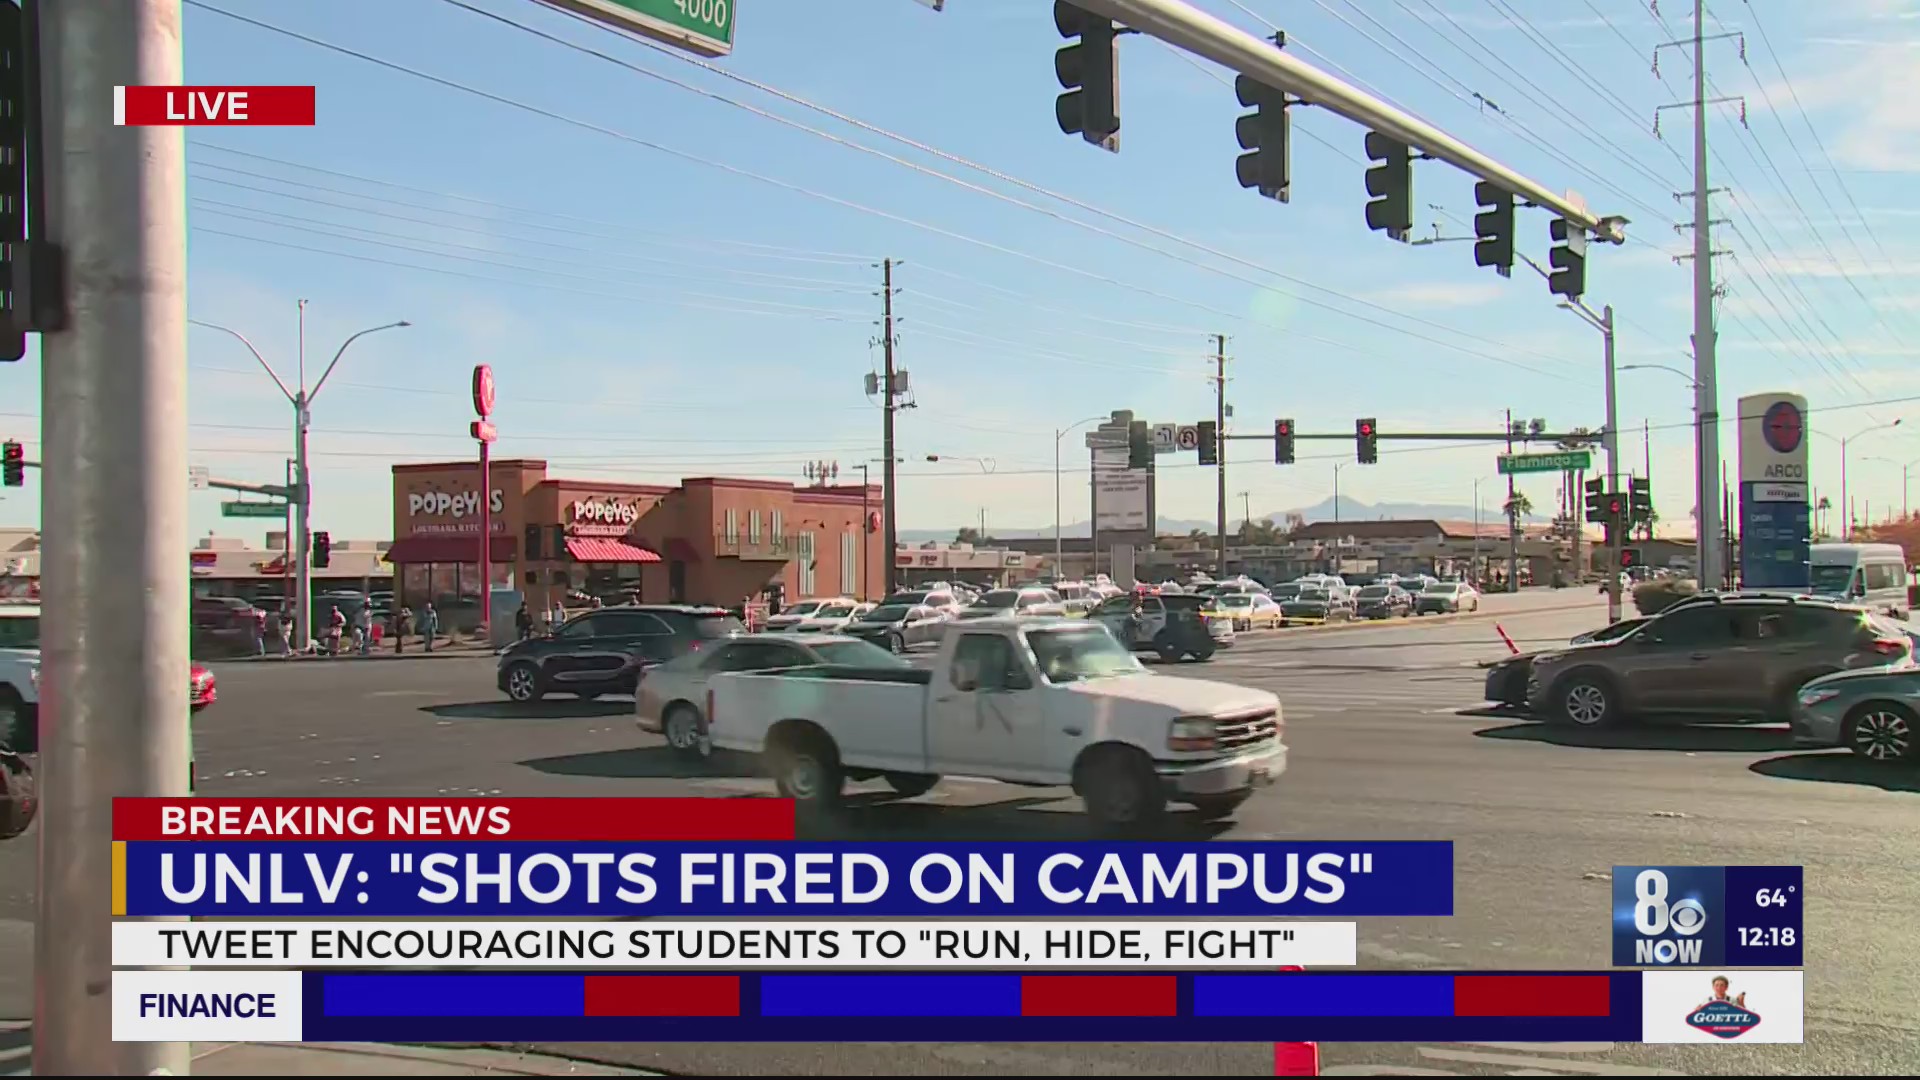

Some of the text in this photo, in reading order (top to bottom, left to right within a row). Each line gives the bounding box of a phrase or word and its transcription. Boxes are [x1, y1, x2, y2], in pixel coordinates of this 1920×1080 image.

[1506, 456, 1571, 468] Flamingo
[1764, 464, 1802, 478] ARCO
[408, 489, 504, 518] POPeYS
